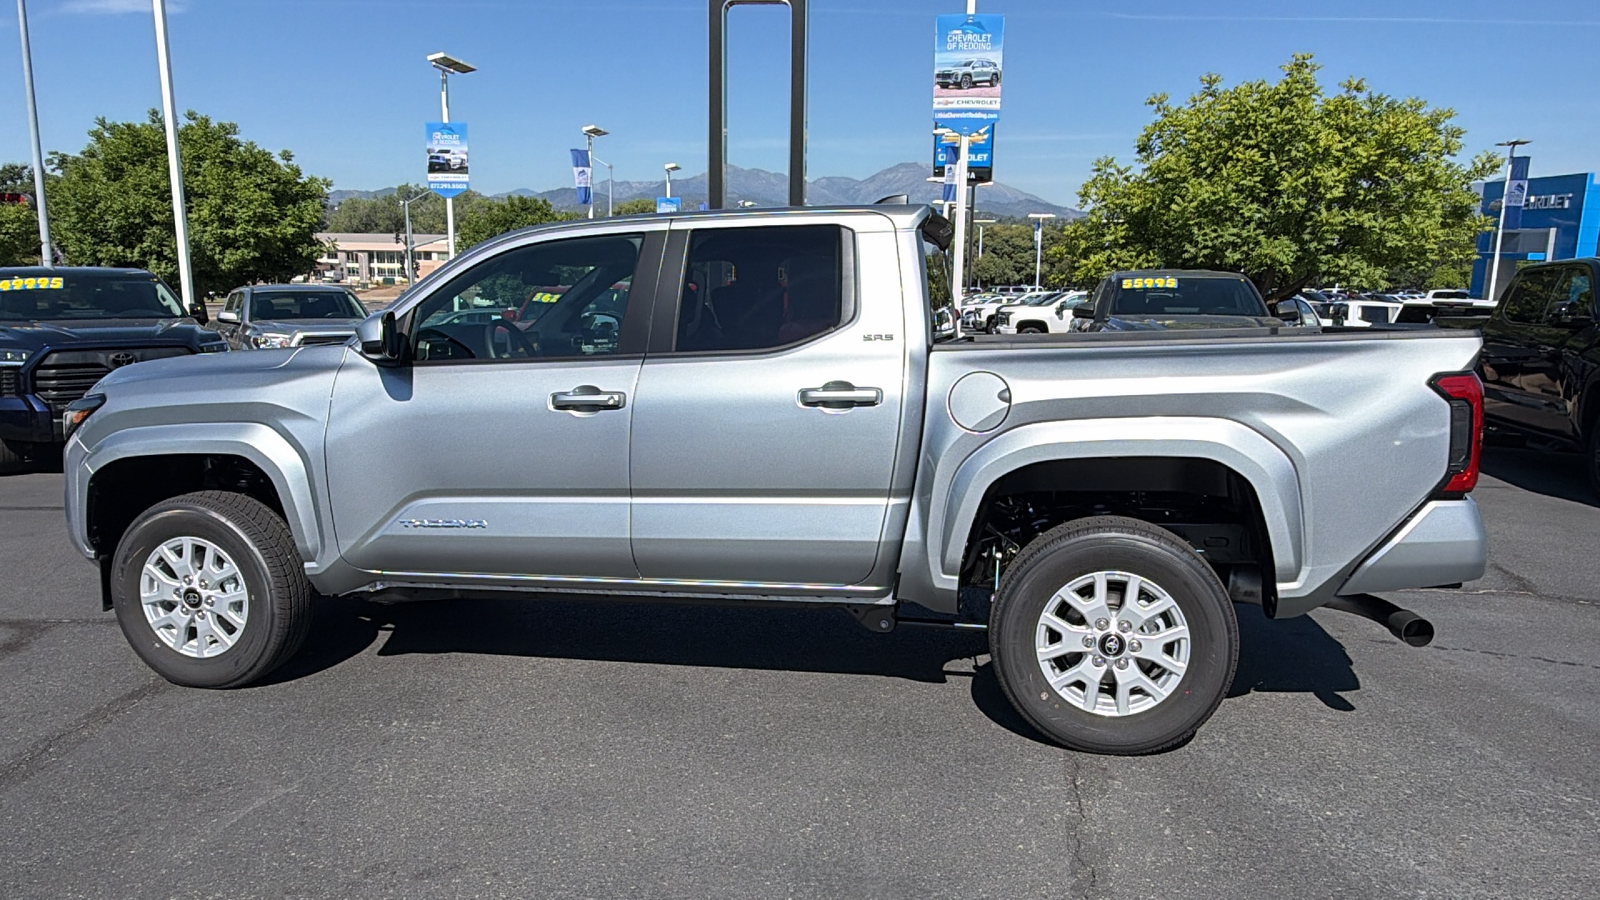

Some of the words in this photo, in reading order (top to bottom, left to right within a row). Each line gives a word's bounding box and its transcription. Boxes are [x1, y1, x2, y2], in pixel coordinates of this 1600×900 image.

[947, 34, 992, 42] CHEVROLET
[947, 42, 957, 50] OF
[959, 42, 992, 50] REDDING
[1522, 193, 1573, 209] EVROLET
[1122, 278, 1176, 289] 55995
